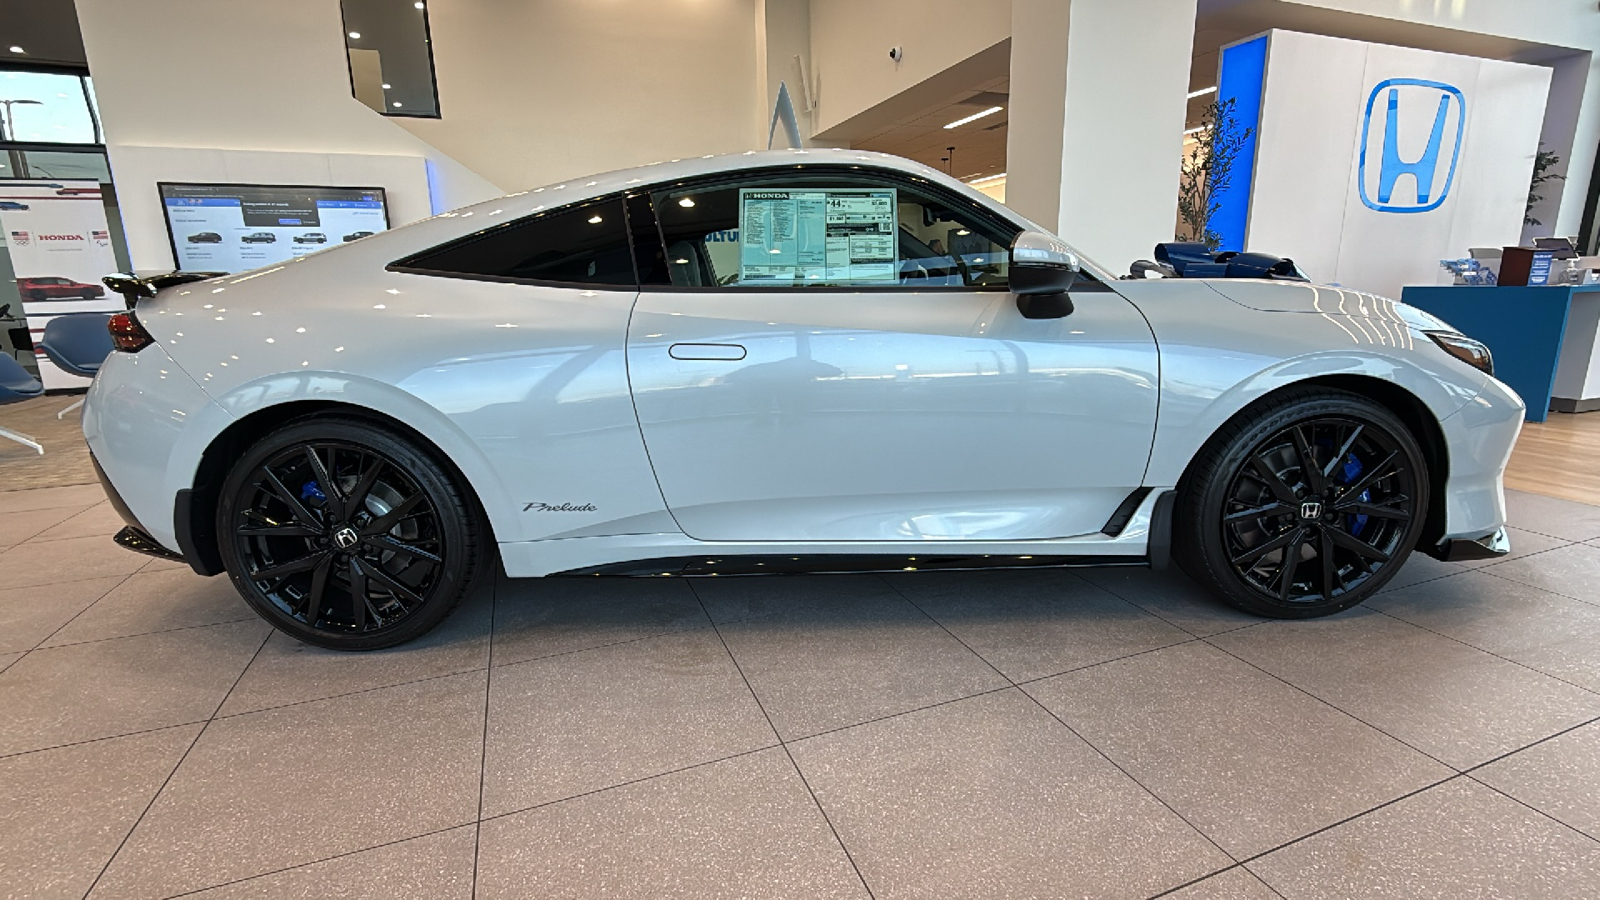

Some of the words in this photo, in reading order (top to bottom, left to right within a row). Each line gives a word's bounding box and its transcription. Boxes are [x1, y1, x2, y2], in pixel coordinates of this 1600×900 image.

[830, 199, 841, 207] 44
[705, 231, 739, 243] ULTU
[522, 502, 598, 512] Prelude
